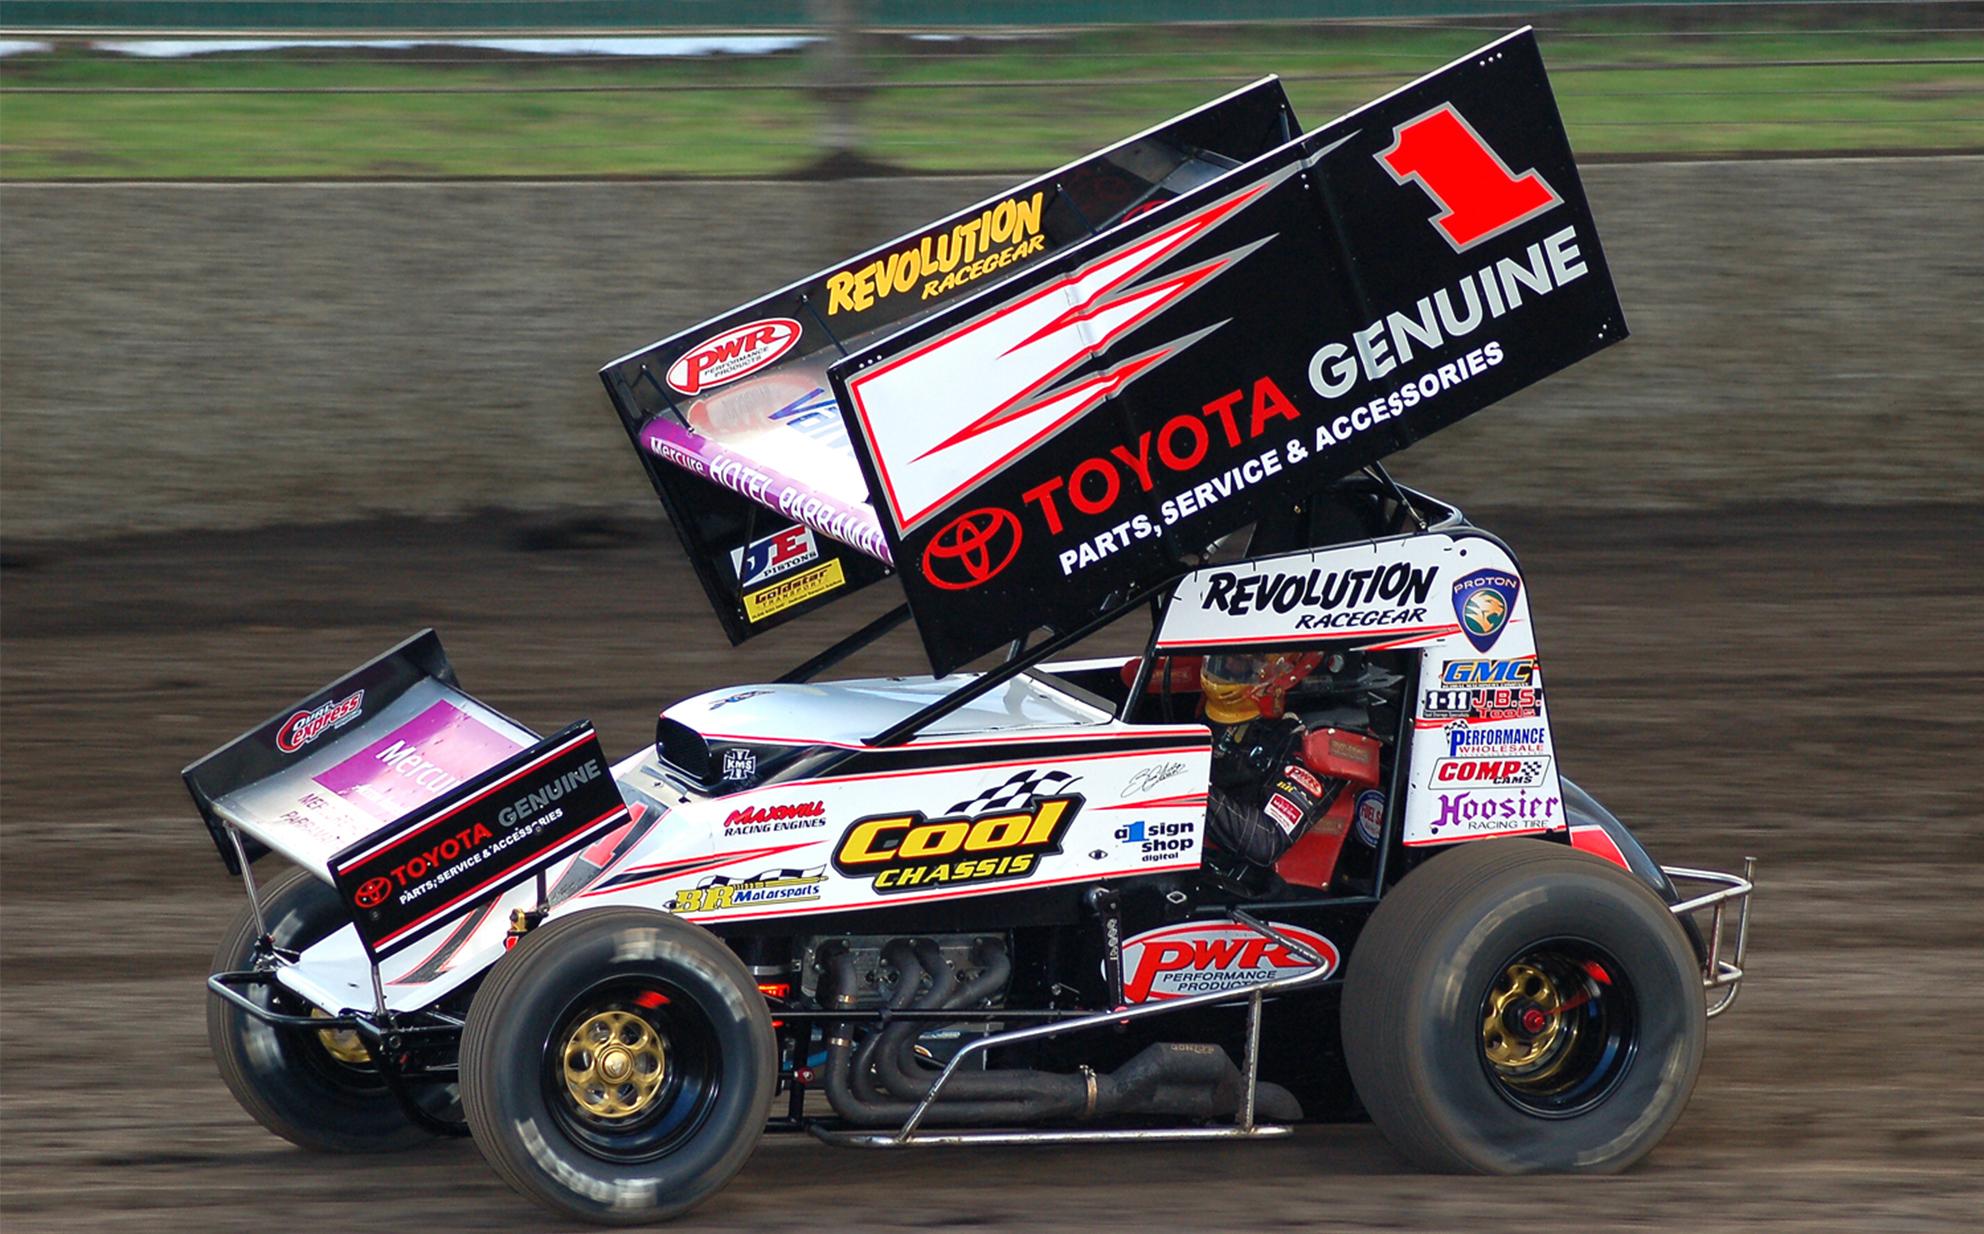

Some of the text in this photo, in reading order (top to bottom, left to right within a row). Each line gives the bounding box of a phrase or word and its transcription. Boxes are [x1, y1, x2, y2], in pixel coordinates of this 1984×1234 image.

[1373, 101, 1565, 254] 1
[826, 192, 1044, 316] REVOLUTION
[921, 234, 1045, 300] RACEGEAR
[1308, 224, 1588, 398] GENUINE
[684, 325, 781, 394] PWR
[704, 346, 769, 377] PERFORMANCE
[714, 356, 762, 378] PRODUCTS
[1162, 455, 1284, 526] SERVICE
[1286, 439, 1308, 463] &
[1315, 341, 1504, 449] ACCESSORIES
[1022, 376, 1300, 535] TOYOTA
[650, 436, 894, 567] Mercure HOTEL PARRAMAT
[743, 525, 808, 585] JE
[763, 552, 817, 577] PISTONS
[1202, 562, 1439, 615] REVOLUTION
[1453, 576, 1517, 595] PROTON
[1295, 608, 1428, 629] RACEGEAR
[1443, 660, 1533, 683] GMC
[291, 694, 361, 746] express
[1450, 727, 1545, 756] PERFORMANCE
[1459, 744, 1544, 753] WHOLESALE
[376, 740, 455, 795] Mercu
[726, 758, 752, 770] KMS
[1438, 761, 1522, 781] COMP
[1493, 776, 1533, 784] CAMS
[390, 822, 493, 886] TOYOTA
[498, 759, 601, 827] GENUINE
[1430, 789, 1559, 826] Hoosier
[483, 848, 492, 859] &
[492, 808, 563, 854] ACCESSORIES
[724, 817, 826, 837] RACING ENGINES
[839, 800, 1070, 864] Cool
[1148, 822, 1194, 837] sign
[1468, 818, 1549, 830] RACING TIRE
[1142, 838, 1194, 852] shop
[1142, 852, 1179, 862] digital
[875, 853, 1035, 889] CHASSIS
[673, 884, 820, 914] BR Motorsports
[1124, 938, 1317, 1004] PWR
[1163, 970, 1278, 983] PERFORMANCE
[1177, 980, 1259, 991] PRODUCT
